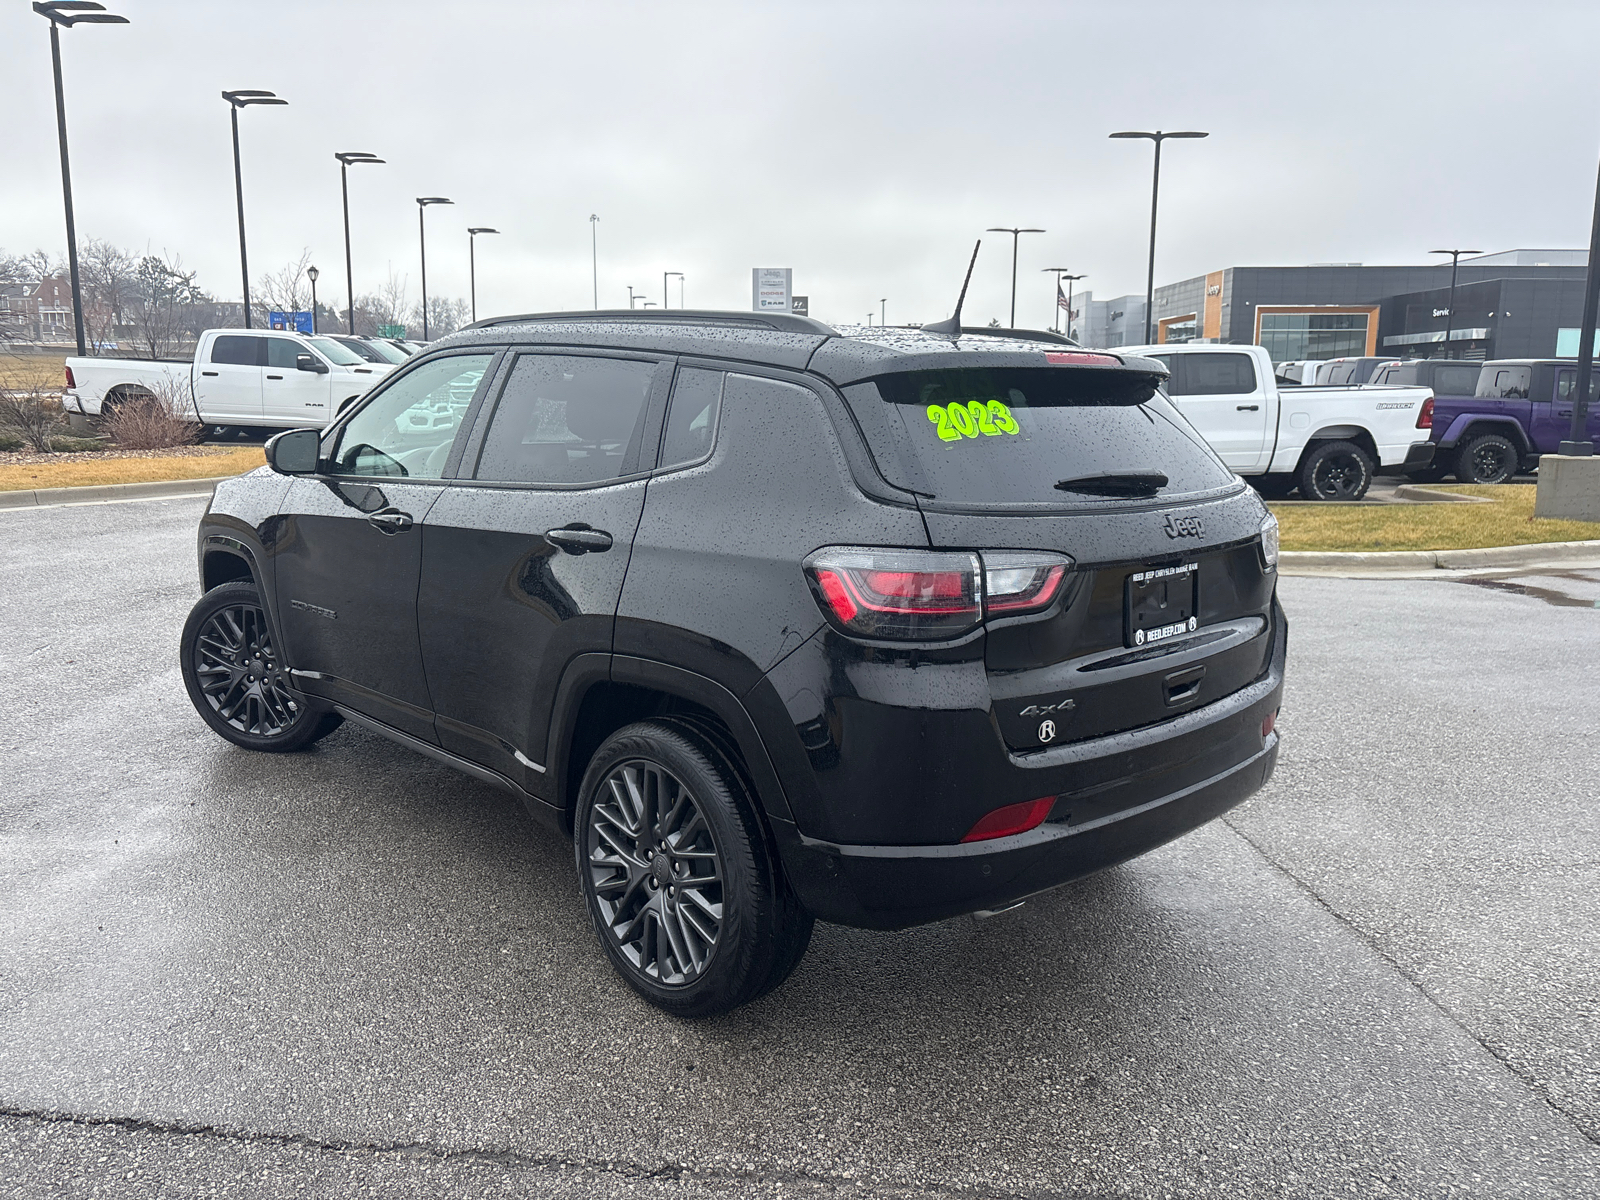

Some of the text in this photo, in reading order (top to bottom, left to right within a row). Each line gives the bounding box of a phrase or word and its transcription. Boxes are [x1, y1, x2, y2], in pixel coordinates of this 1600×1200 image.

[764, 269, 781, 278] Jeep
[1432, 307, 1455, 318] Servic
[926, 399, 1020, 442] 2023
[1162, 513, 1206, 542] Jeep
[1132, 573, 1144, 582] REED
[1145, 571, 1155, 580] JEEP
[1155, 567, 1175, 578] CHRYSLER
[1176, 565, 1188, 573] DODGE
[1147, 623, 1186, 642] REEDJEEP.COM
[1019, 698, 1076, 718] 4x4
